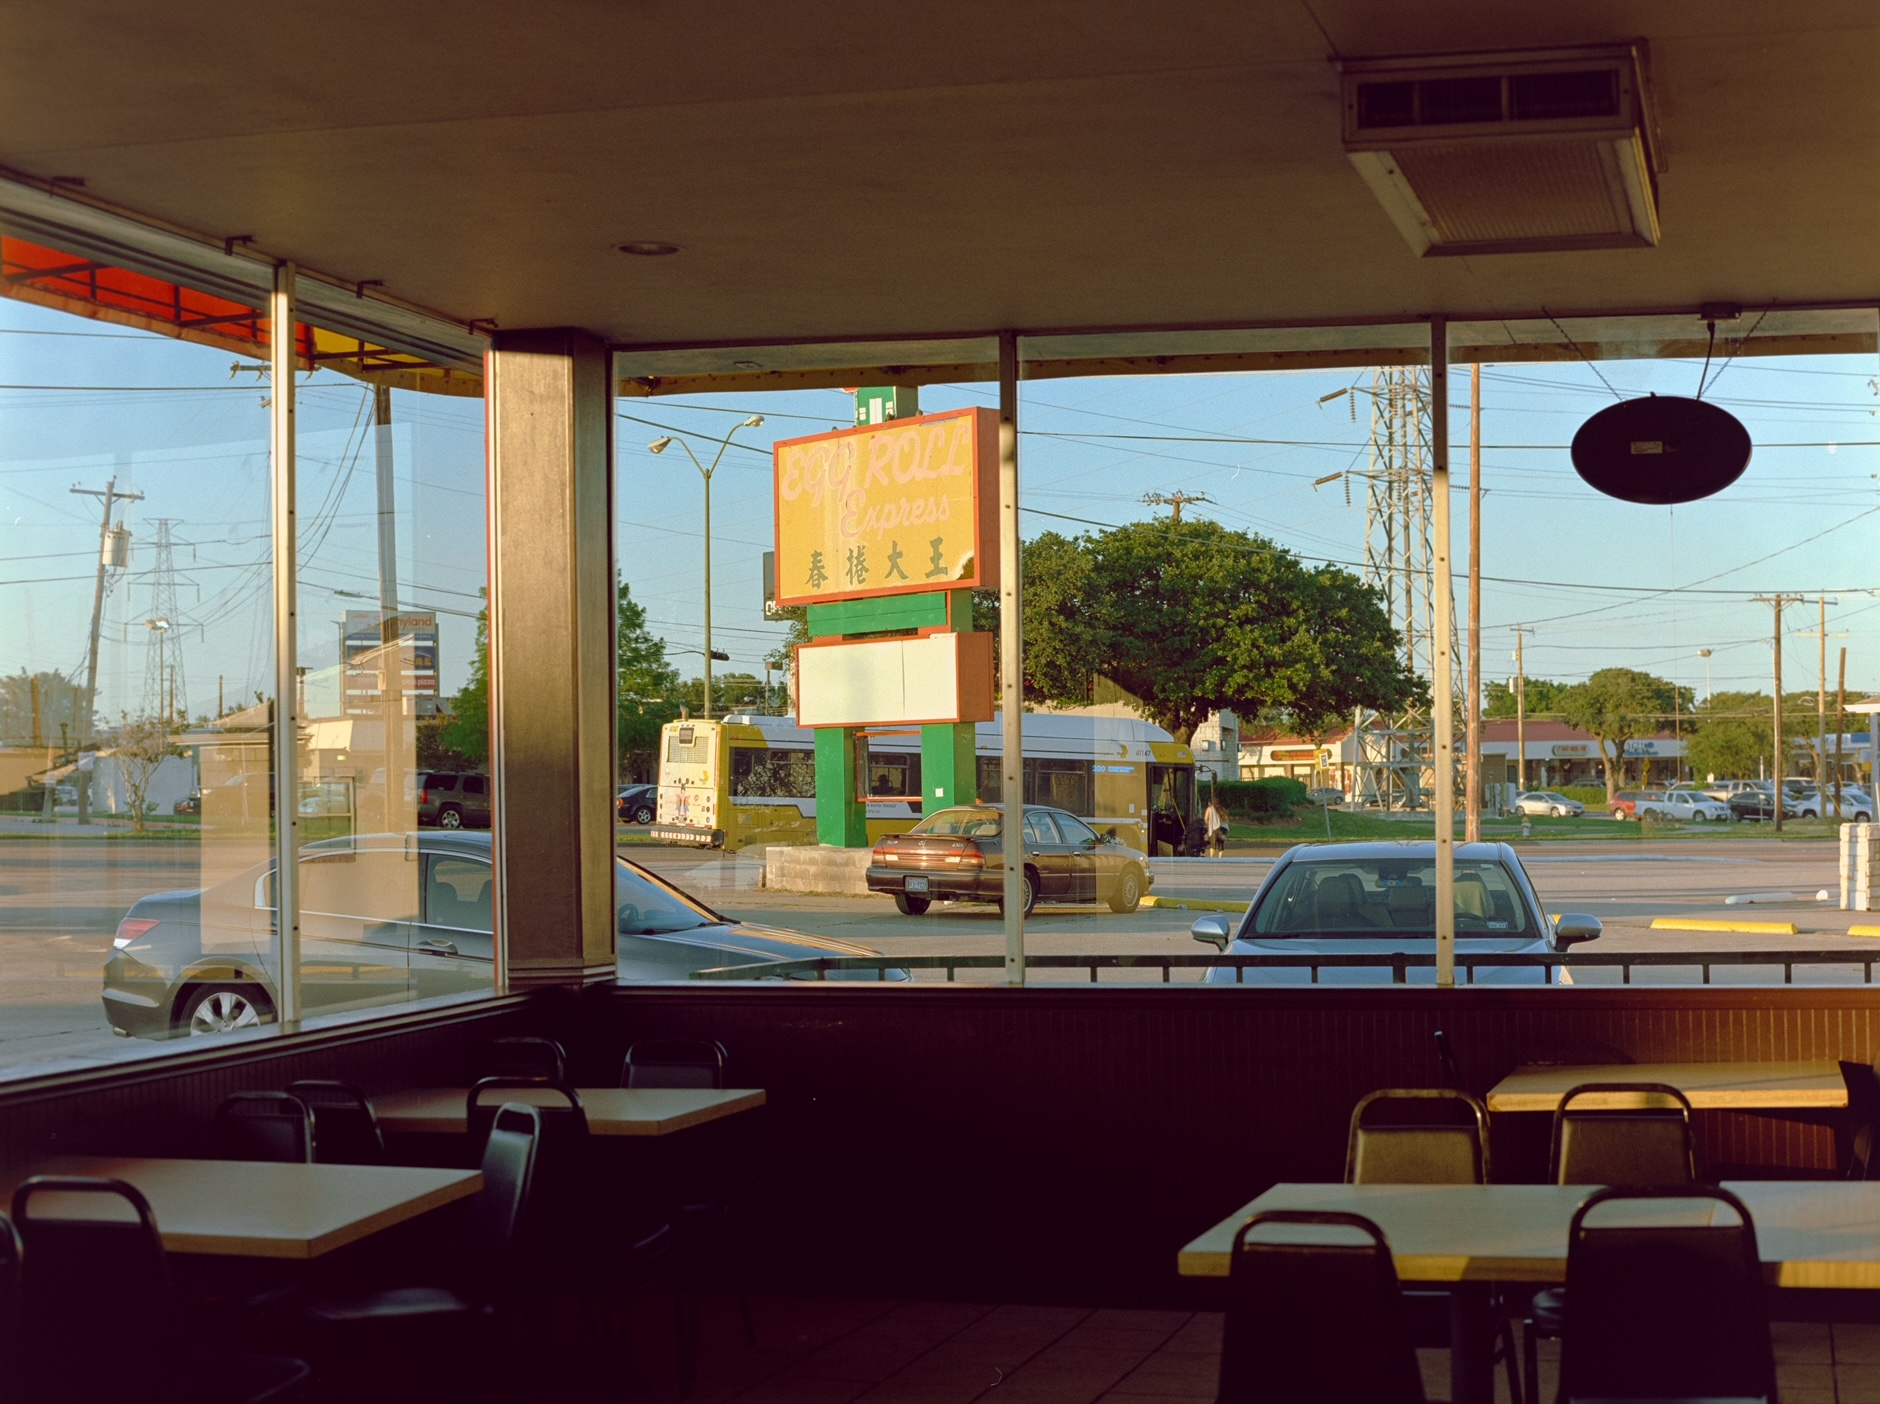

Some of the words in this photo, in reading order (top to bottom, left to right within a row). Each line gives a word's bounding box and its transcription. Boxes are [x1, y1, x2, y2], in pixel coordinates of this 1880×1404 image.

[864, 425, 970, 488] ROLL
[841, 488, 950, 540] Express
[417, 678, 435, 686] pizza
